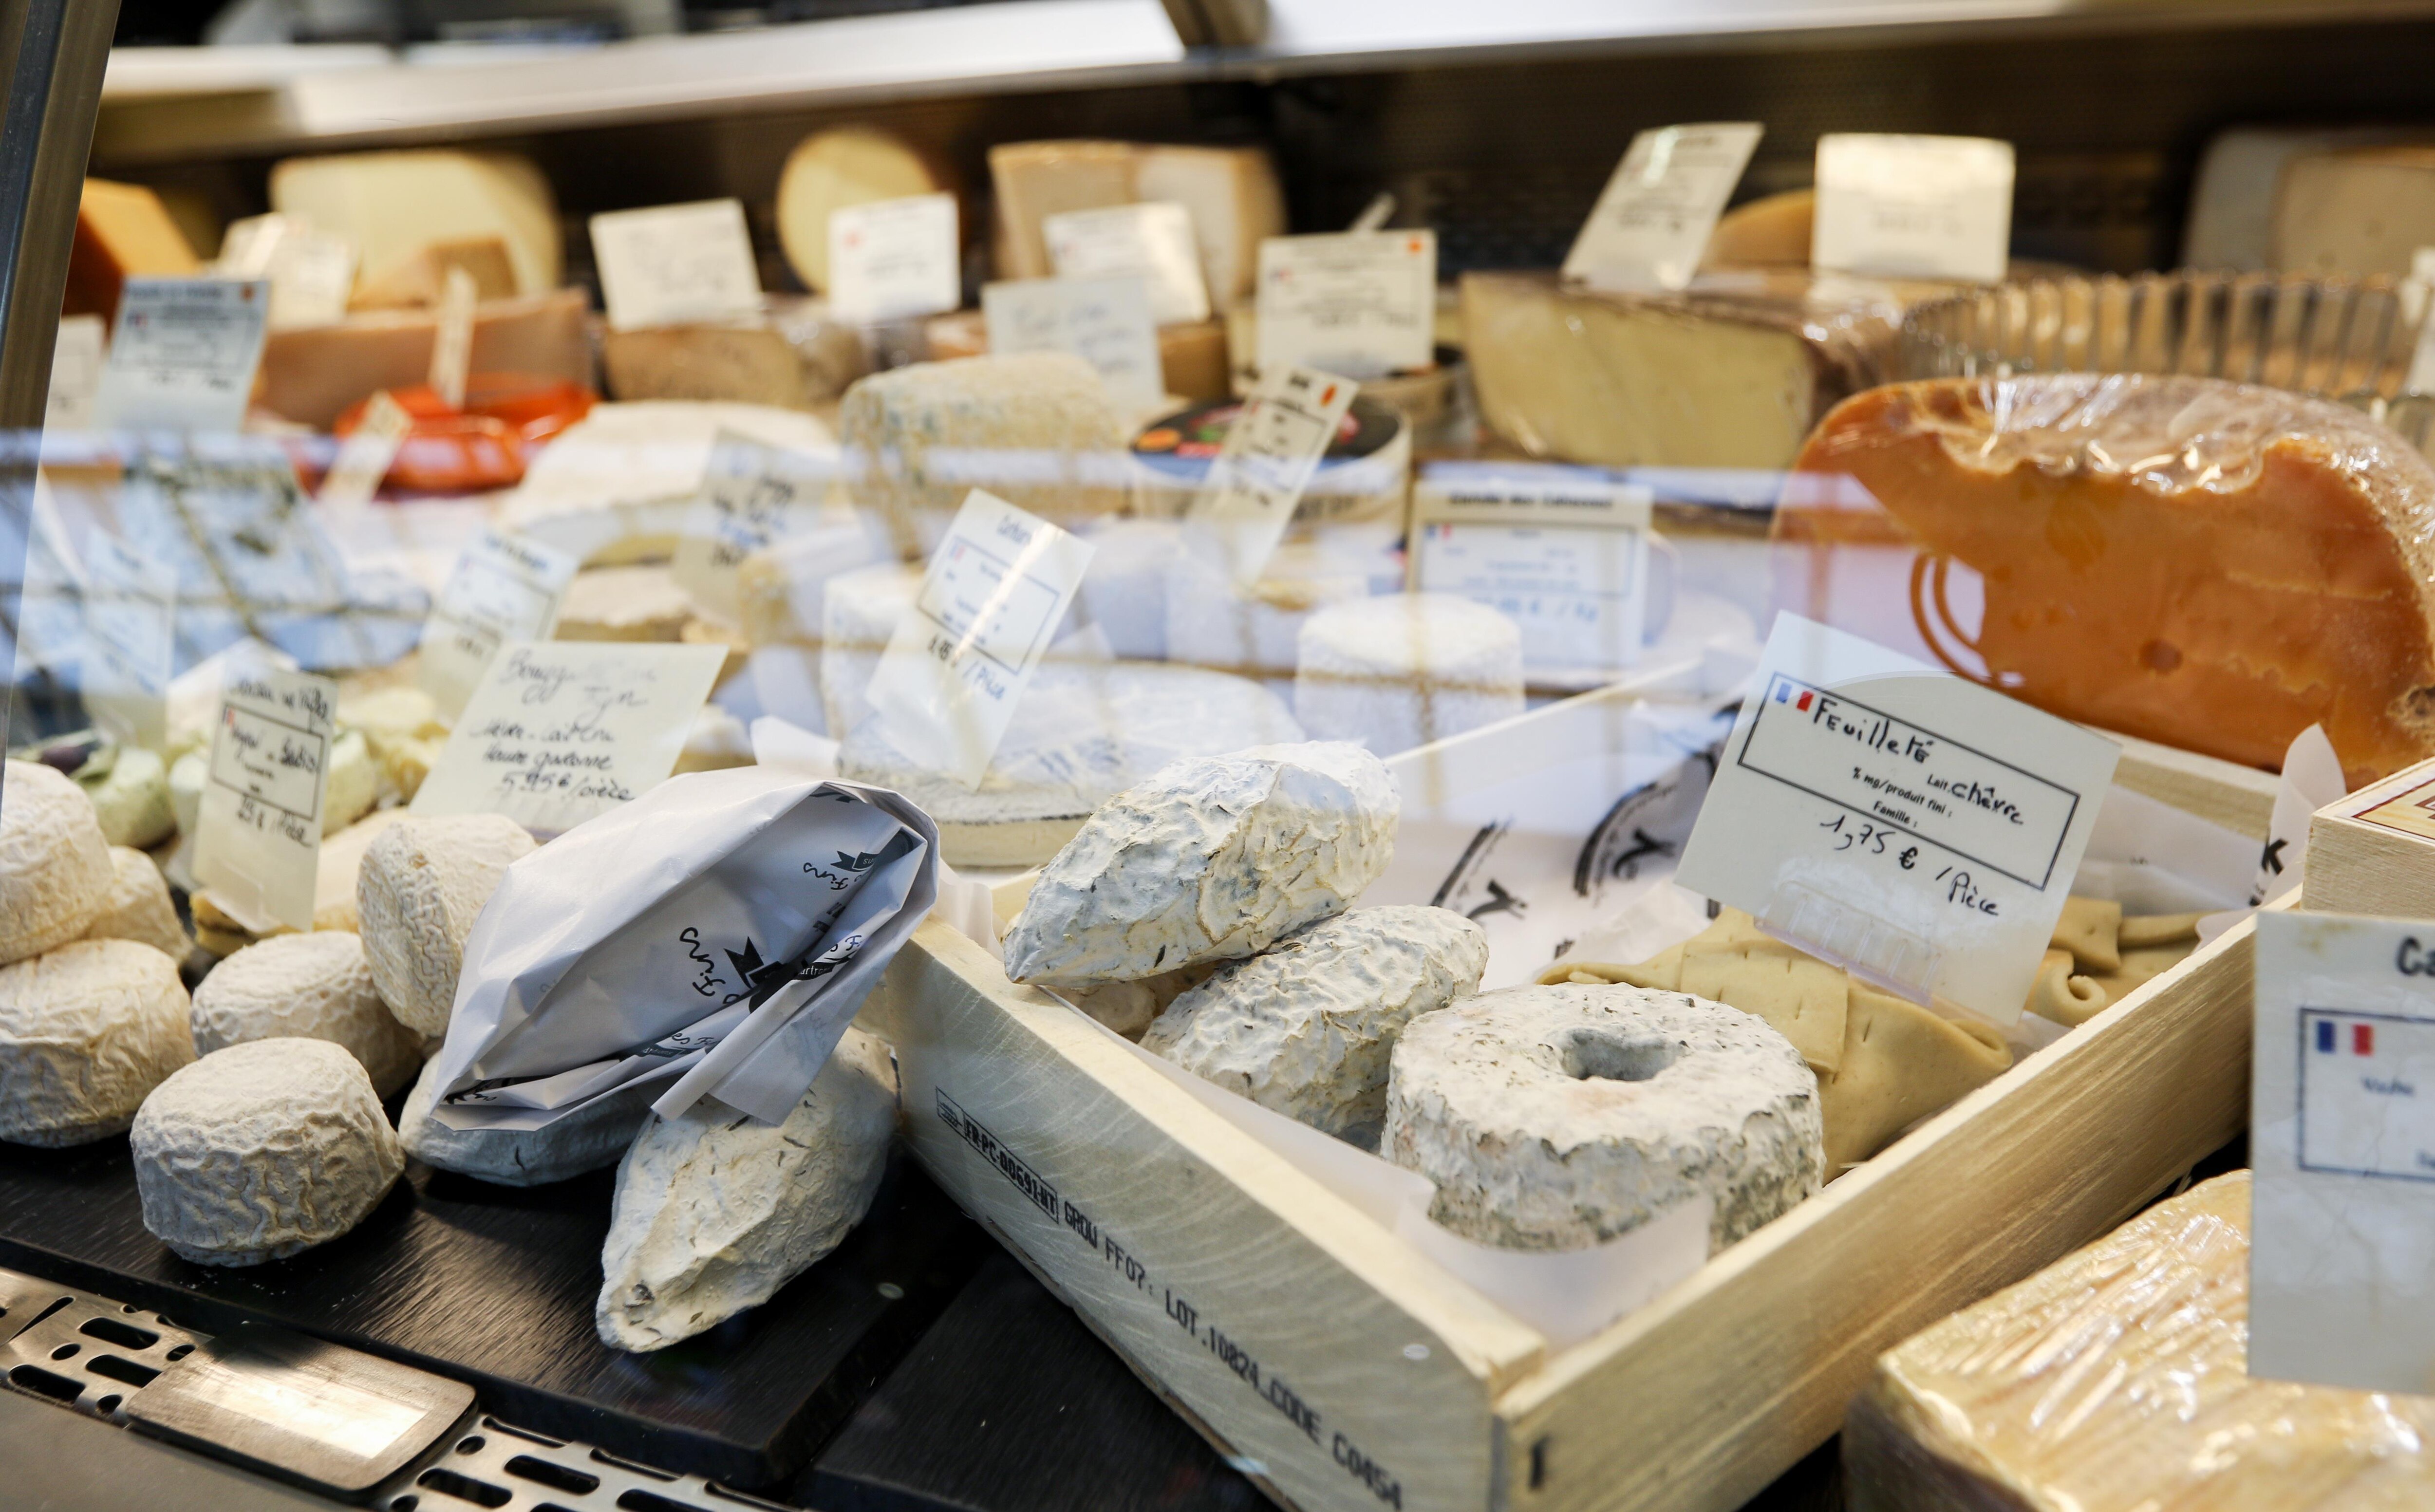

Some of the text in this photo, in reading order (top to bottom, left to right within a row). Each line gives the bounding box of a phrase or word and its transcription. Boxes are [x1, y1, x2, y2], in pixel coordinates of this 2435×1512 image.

[1864, 774, 1925, 805] mg/produit
[1819, 815, 1896, 854] 1,75
[1898, 846, 1918, 870] €
[1166, 1288, 1199, 1336] LOT
